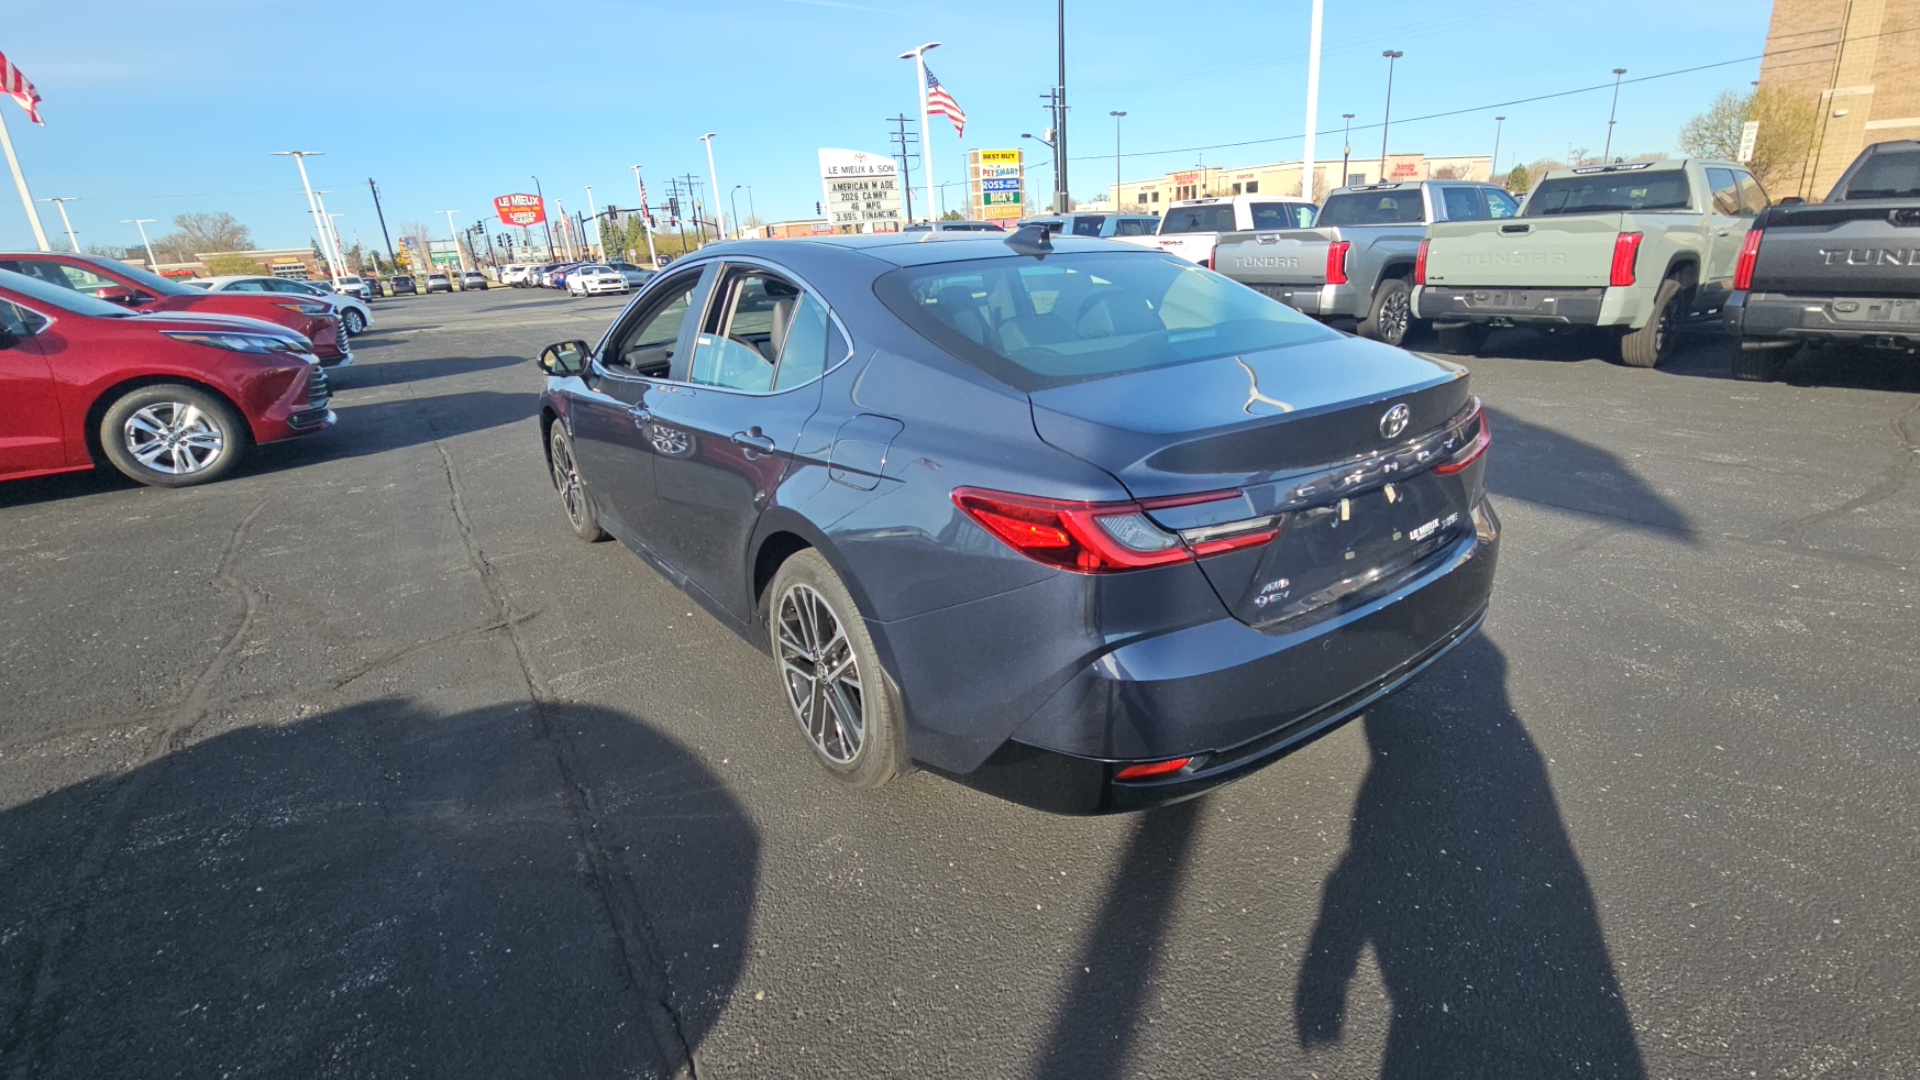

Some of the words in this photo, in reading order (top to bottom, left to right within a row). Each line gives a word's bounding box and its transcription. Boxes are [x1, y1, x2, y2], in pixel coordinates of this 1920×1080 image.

[828, 166, 838, 174] LE
[841, 165, 866, 174] MIEUX
[869, 165, 874, 173] &
[877, 165, 895, 173] SON
[983, 167, 1018, 177] PETSMART
[832, 182, 869, 191] AMERICAN
[498, 197, 510, 206] LE
[510, 194, 539, 206] MIEUX
[862, 191, 888, 200] CAMRY
[851, 202, 860, 210] 46
[866, 201, 881, 210] MPG
[836, 213, 857, 221] 3.99%
[862, 209, 898, 219] FINANCING
[1234, 256, 1299, 268] TUNDRA
[1461, 252, 1567, 267] TUNDRA
[1410, 529, 1419, 541] LE
[1418, 517, 1440, 536] MIEUX
